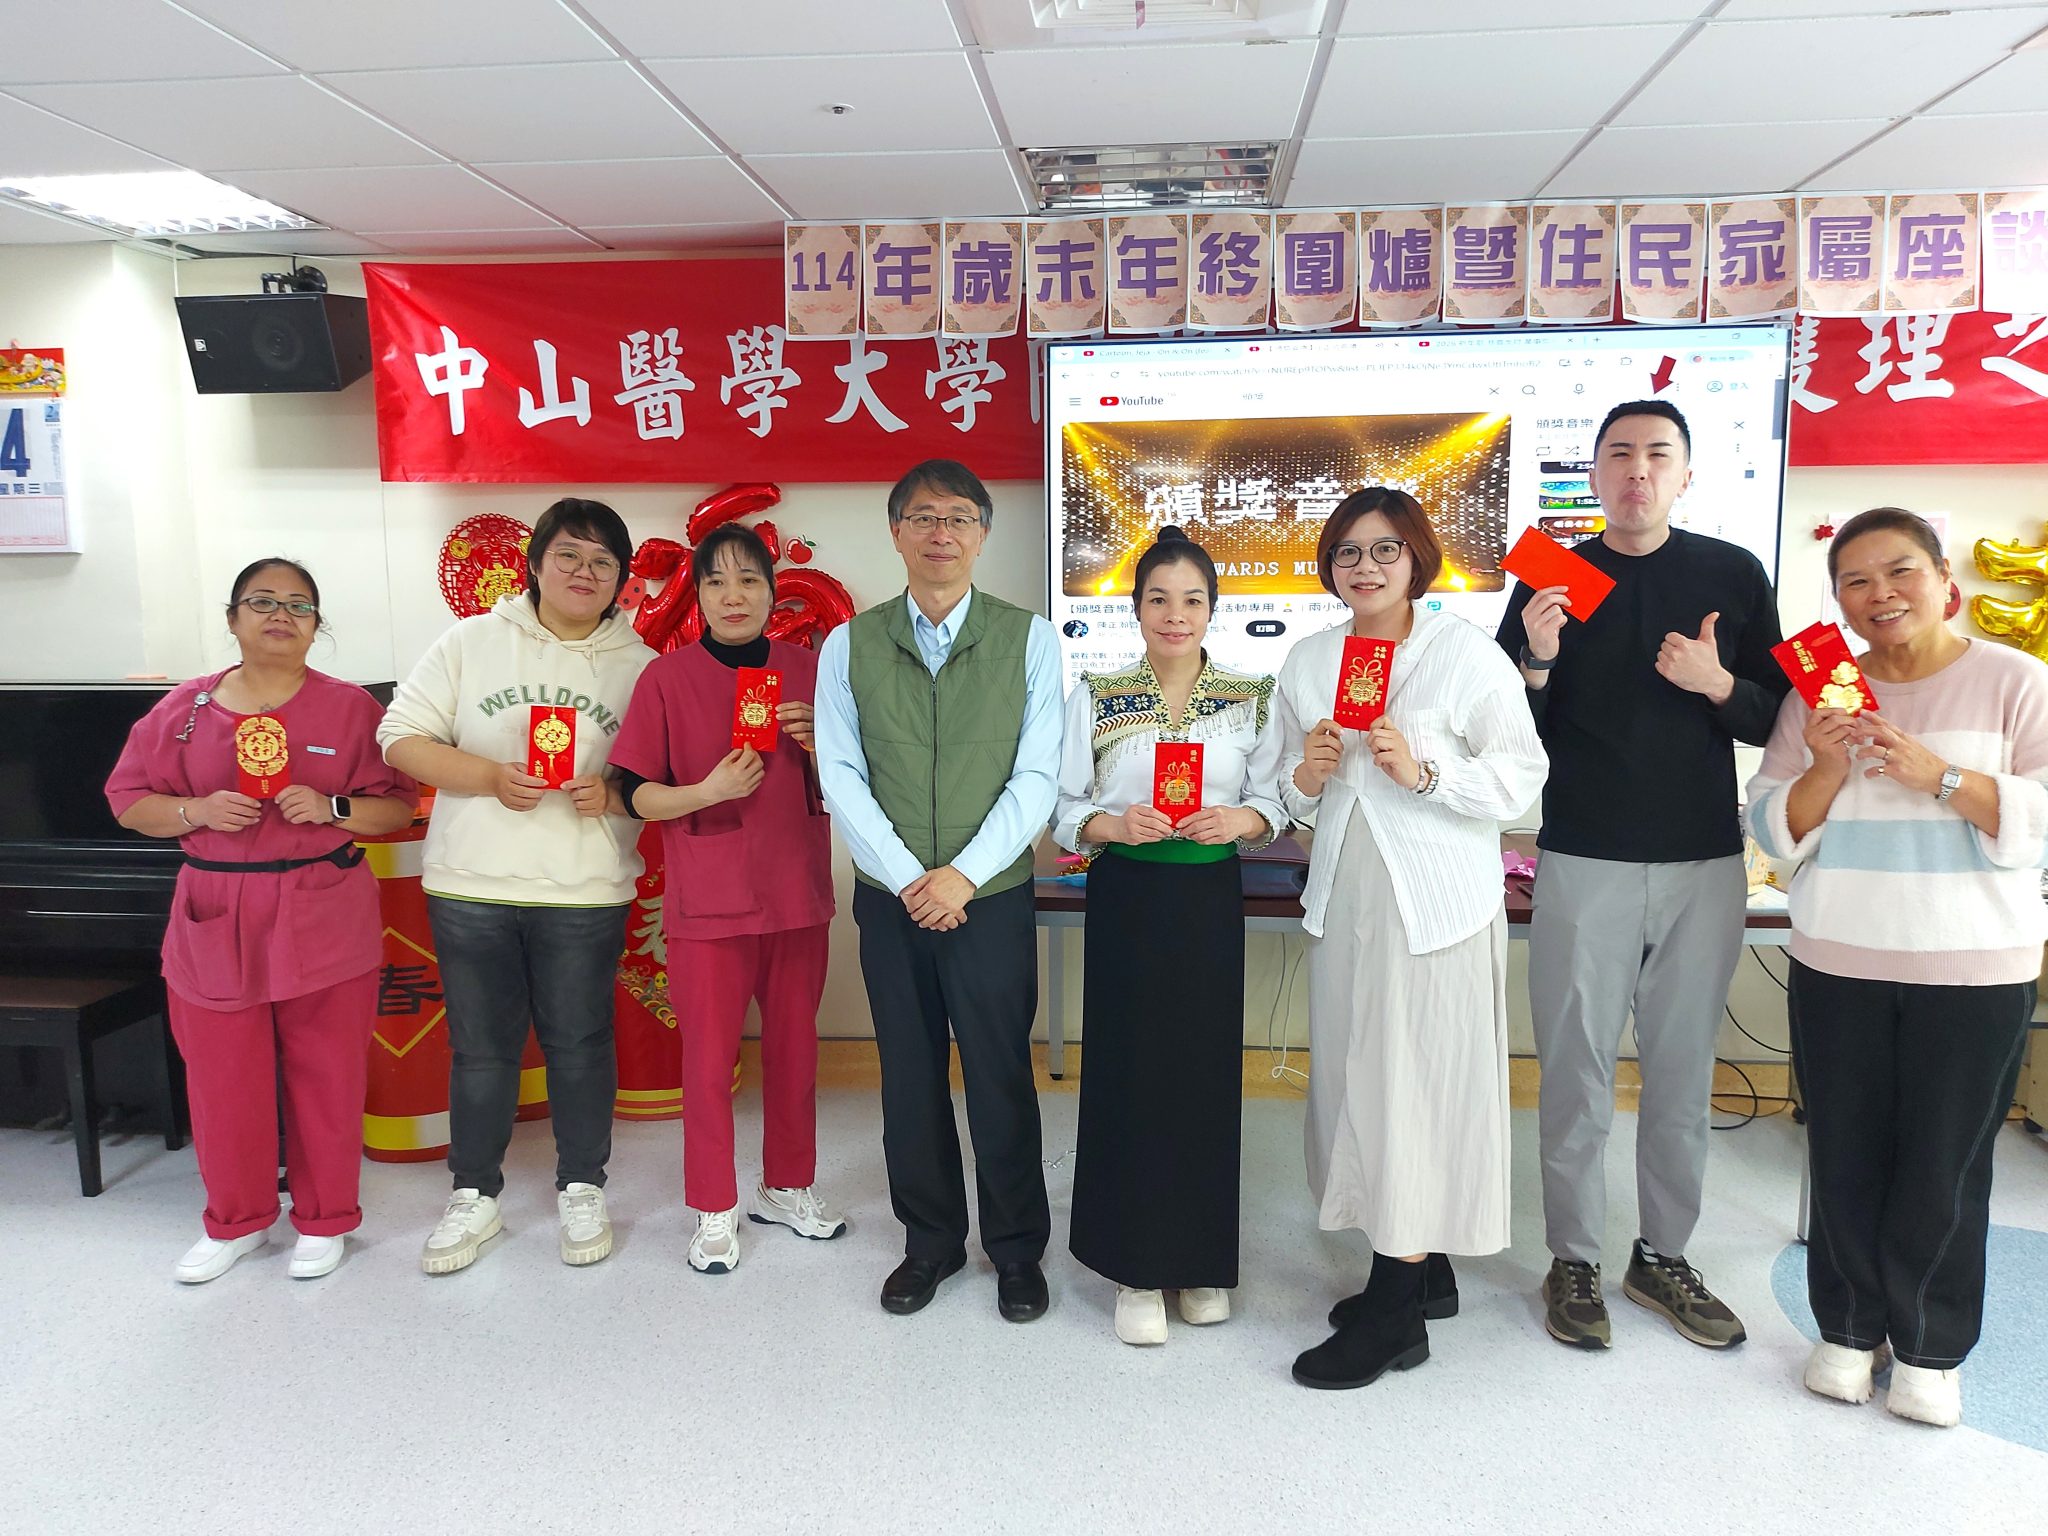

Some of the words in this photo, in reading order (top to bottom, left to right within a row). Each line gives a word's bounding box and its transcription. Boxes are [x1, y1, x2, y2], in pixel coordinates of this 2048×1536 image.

[415, 325, 1043, 441] 中山醫學大學
[1120, 396, 1164, 406] YouTube
[0, 408, 31, 478] 4
[1144, 477, 1420, 530] 頒獎音
[1255, 624, 1277, 633] 訂閱
[477, 683, 621, 738] WELLDONE
[378, 964, 445, 1017] 春
